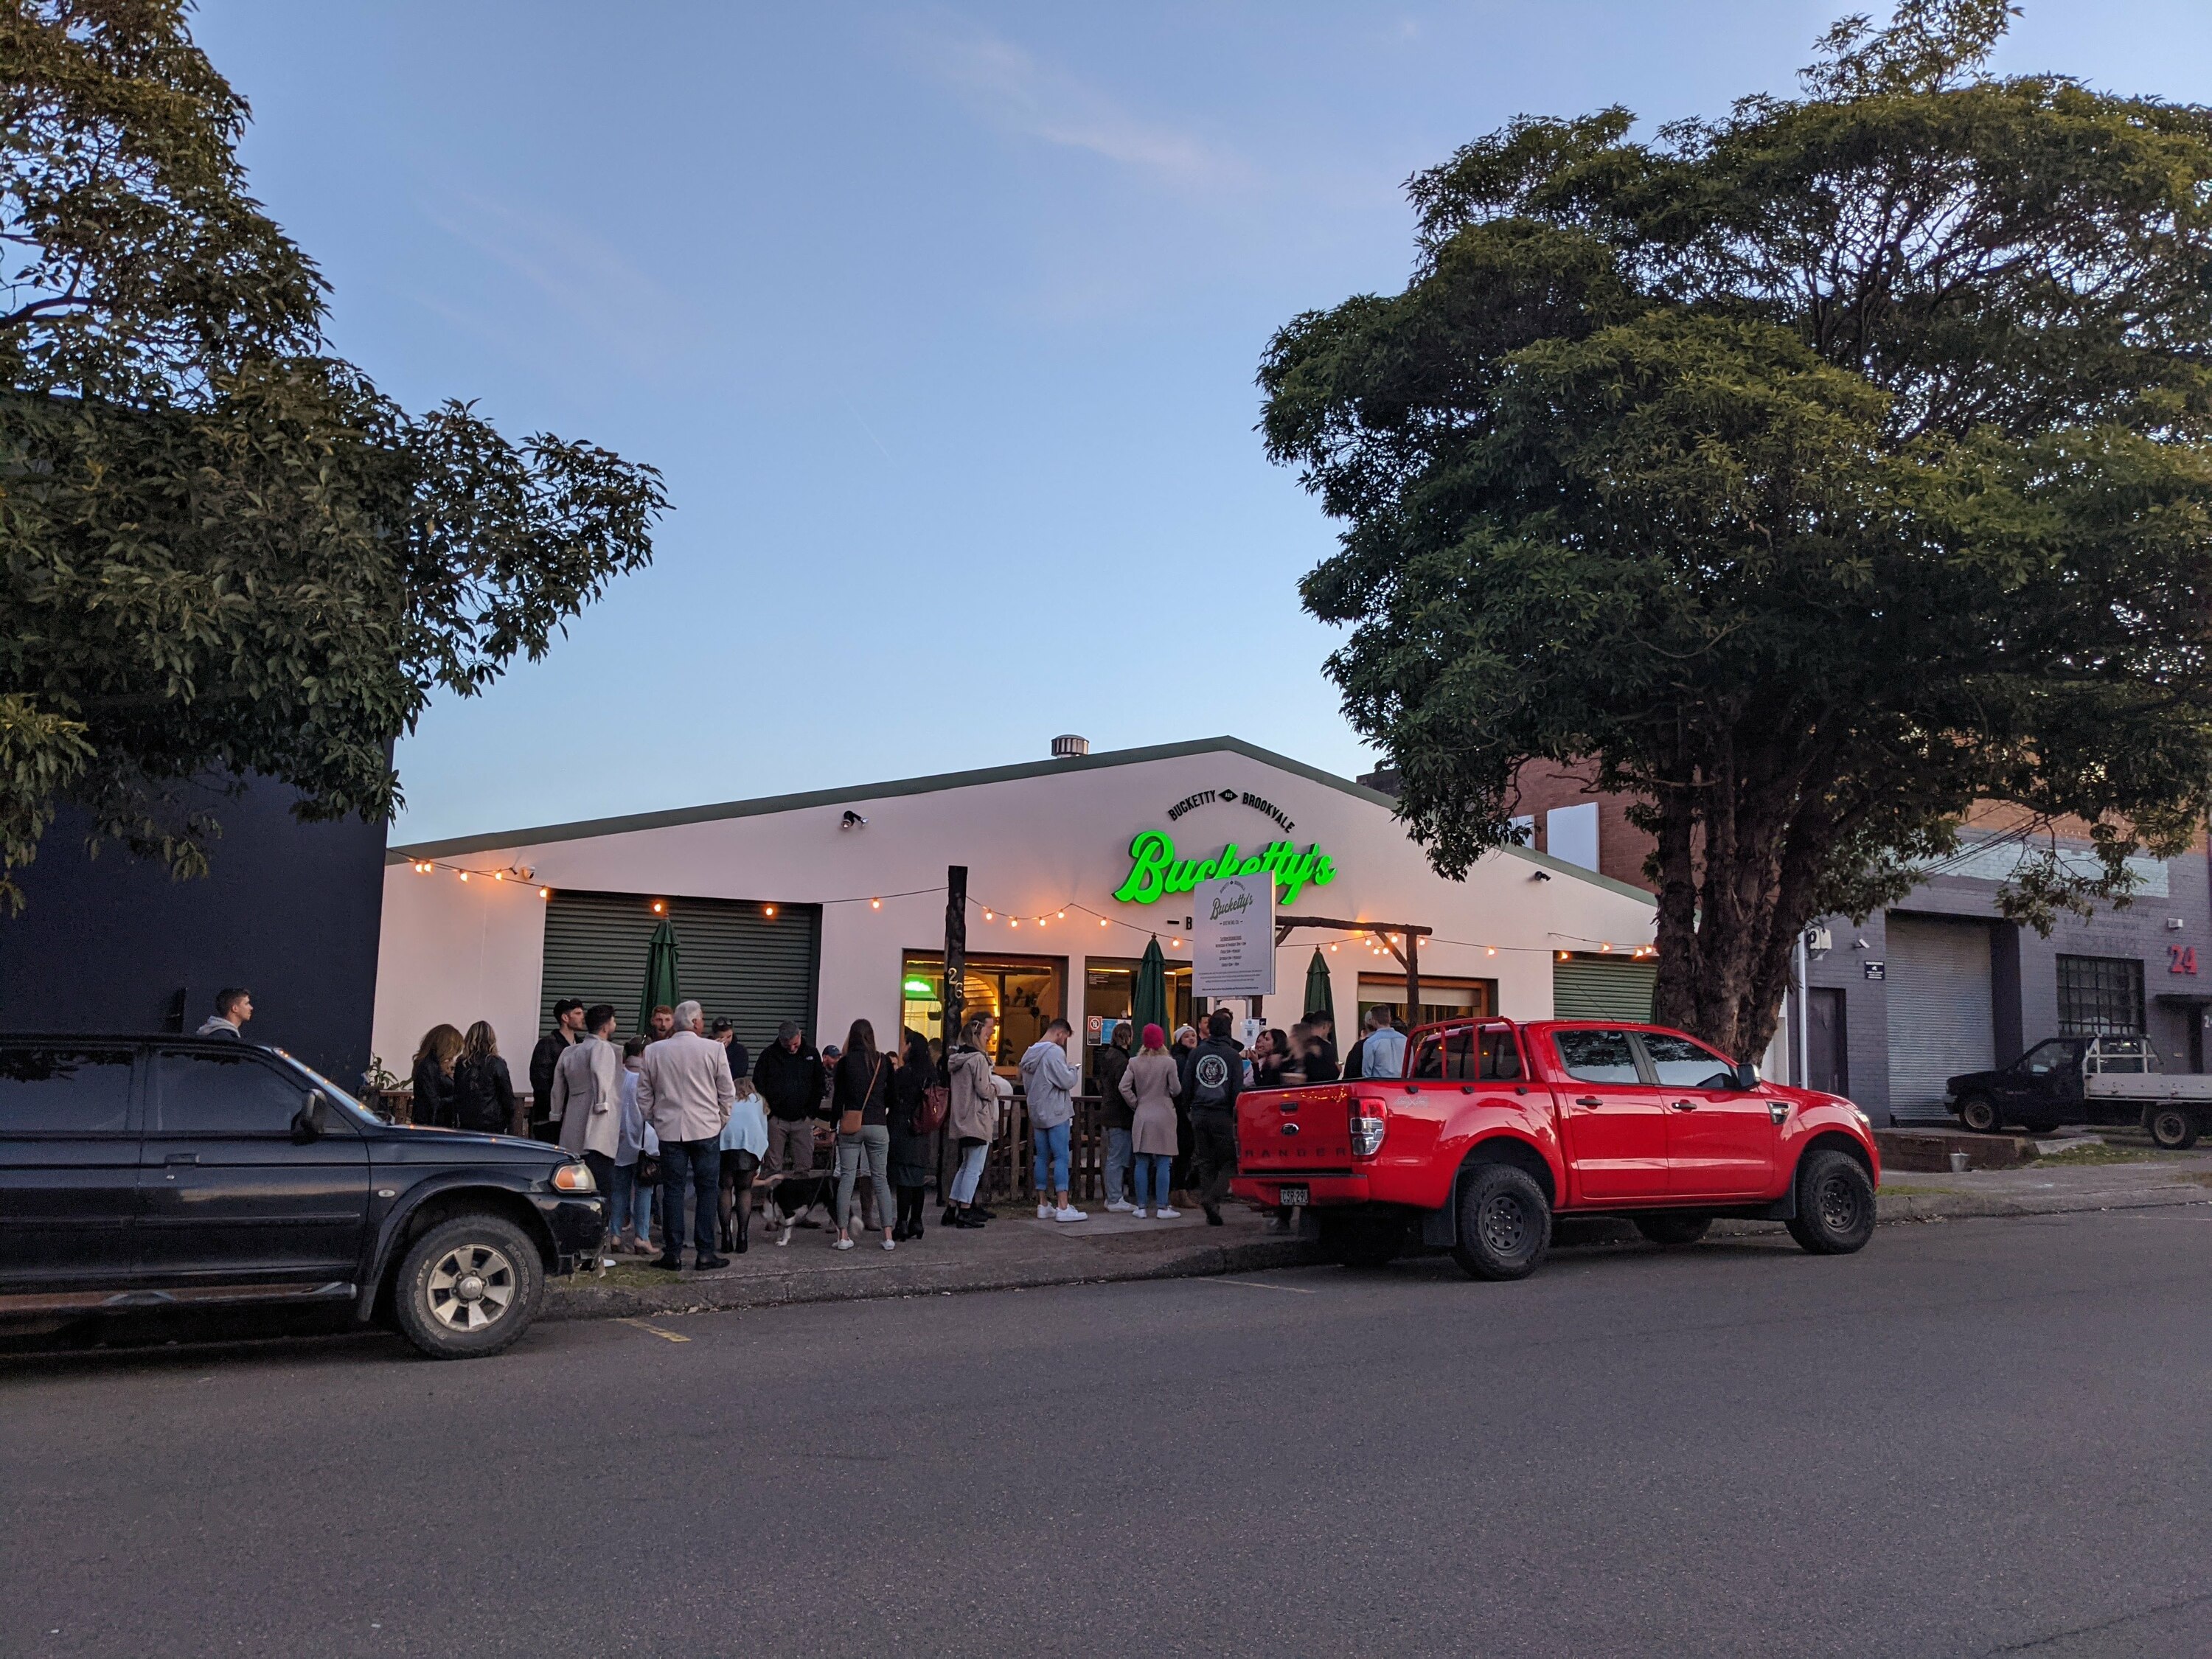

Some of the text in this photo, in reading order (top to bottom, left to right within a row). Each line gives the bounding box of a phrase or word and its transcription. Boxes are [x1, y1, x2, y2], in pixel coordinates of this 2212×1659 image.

[1168, 790, 1216, 821] BUCKETTY
[1242, 792, 1295, 834] BROOKVALE
[1112, 830, 1337, 905] Bucketty's
[1209, 892, 1253, 920] Bucketty's
[2168, 944, 2198, 975] 24
[947, 967, 963, 999] 26
[2204, 1015, 2212, 1028] 2
[1245, 1147, 1346, 1157] RANGER
